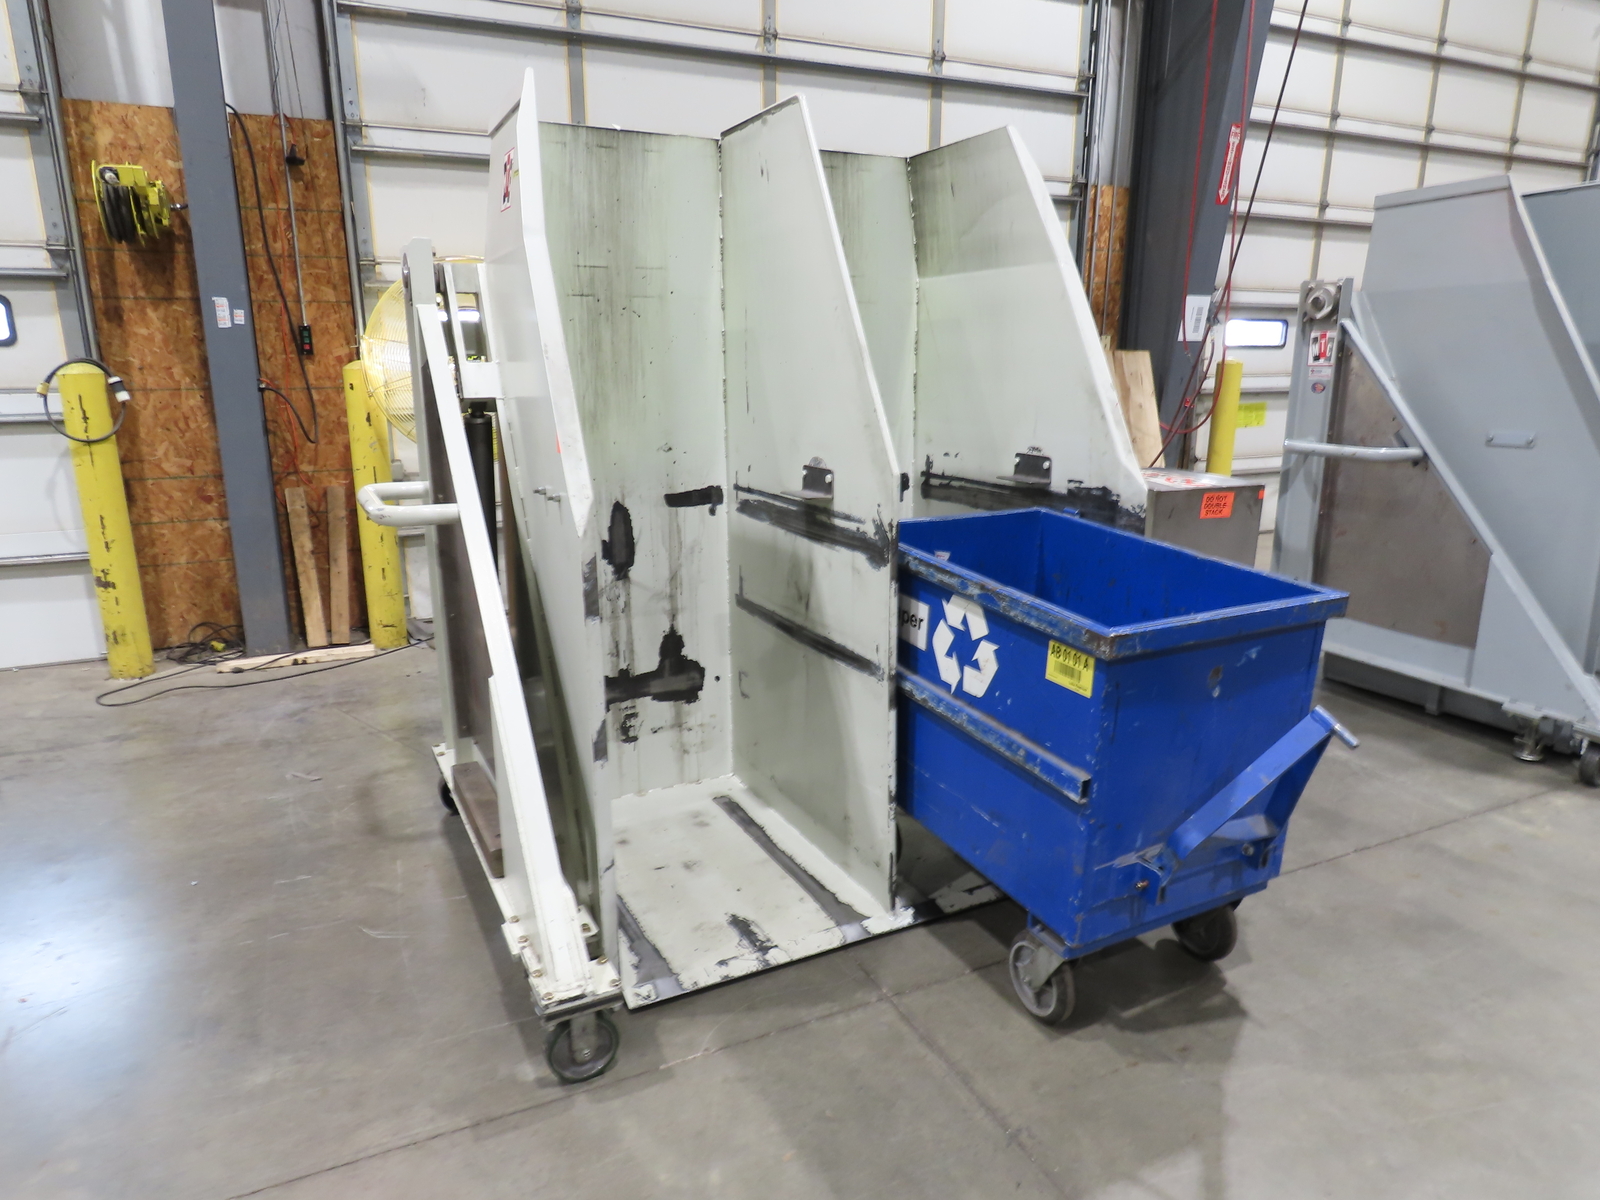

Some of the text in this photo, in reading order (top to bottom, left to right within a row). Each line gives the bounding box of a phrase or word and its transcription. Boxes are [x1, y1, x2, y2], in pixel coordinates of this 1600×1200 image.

[898, 607, 924, 631] per
[1050, 643, 1062, 660] AB
[1083, 656, 1089, 672] A
